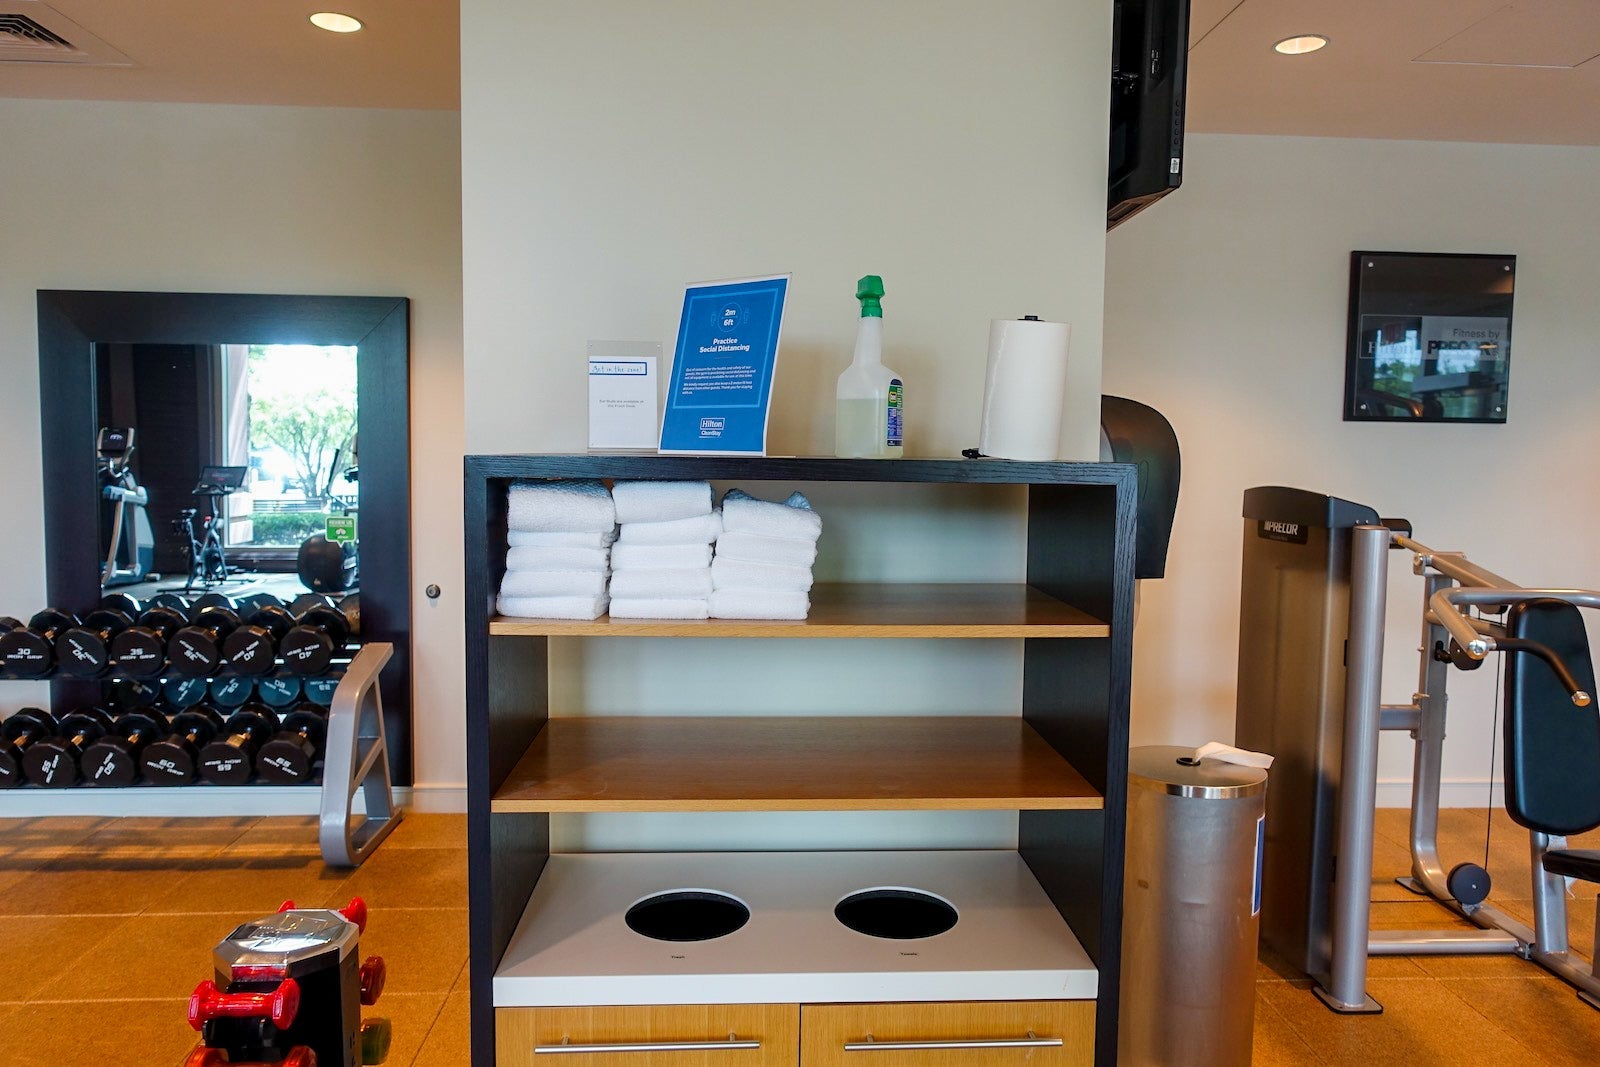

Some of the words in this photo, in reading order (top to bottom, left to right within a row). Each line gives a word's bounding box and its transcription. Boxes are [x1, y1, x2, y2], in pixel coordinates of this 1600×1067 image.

[1453, 328, 1486, 338] Fitness
[1488, 329, 1500, 339] by
[1268, 521, 1298, 535] PRECOR
[244, 650, 255, 661] 40
[298, 651, 312, 659] 40
[41, 760, 51, 773] 55
[104, 762, 115, 775] 60
[147, 761, 164, 770] IRON
[159, 758, 176, 769] 60
